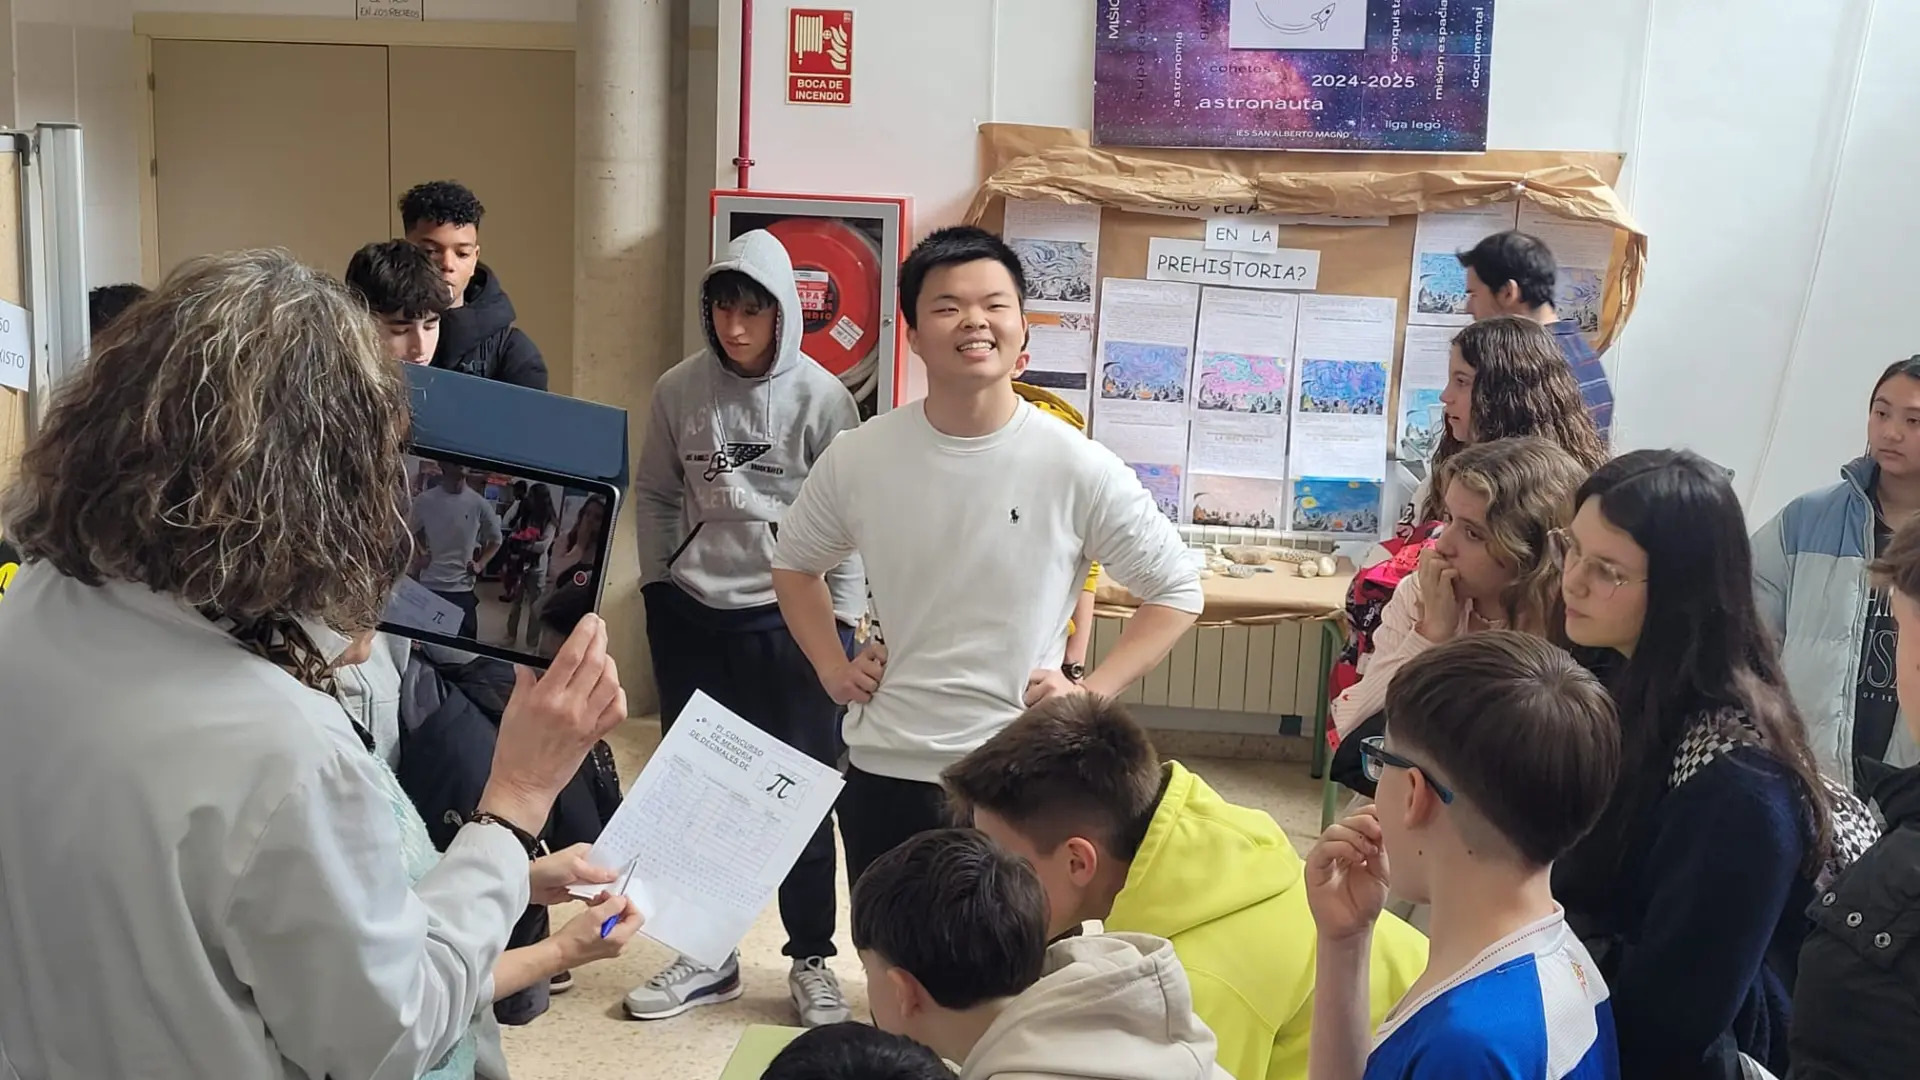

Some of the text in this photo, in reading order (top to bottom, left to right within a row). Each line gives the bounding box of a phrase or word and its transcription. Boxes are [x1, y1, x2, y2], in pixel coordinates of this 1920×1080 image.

[1471, 7, 1485, 88] documental
[1209, 64, 1272, 74] cohetes
[797, 79, 843, 89] BOCA DE
[1311, 74, 1416, 88] 2024-2025
[795, 90, 845, 101] INCENDIO
[1199, 97, 1324, 111] astronauta
[1236, 129, 1250, 137] IES
[1215, 227, 1272, 242] EN LA
[1157, 254, 1307, 281] PREHISTORIA?
[720, 738, 753, 762] MEMORIA
[725, 730, 764, 757] CONCURSO
[700, 736, 739, 767] DECIMALES
[766, 773, 796, 799] π
